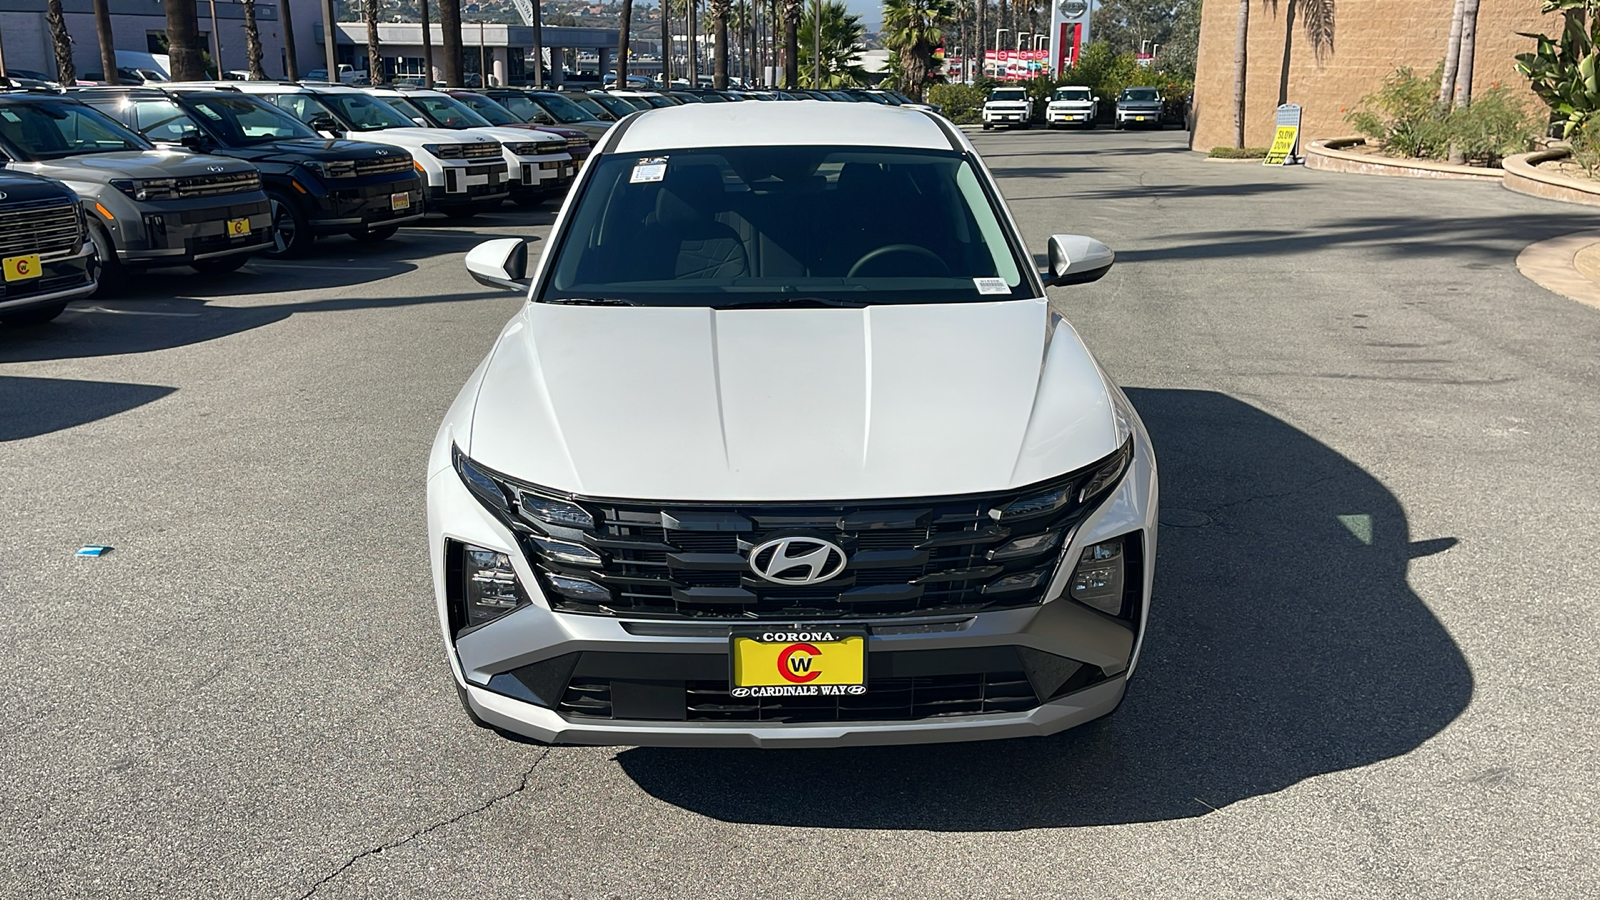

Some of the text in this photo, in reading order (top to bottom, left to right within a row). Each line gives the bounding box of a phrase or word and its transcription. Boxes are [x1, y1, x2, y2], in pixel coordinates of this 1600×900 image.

[1277, 130, 1295, 139] SLOW
[1274, 141, 1291, 150] DOWN
[762, 632, 834, 642] CORONA
[751, 685, 848, 697] CARDINALE WAY
